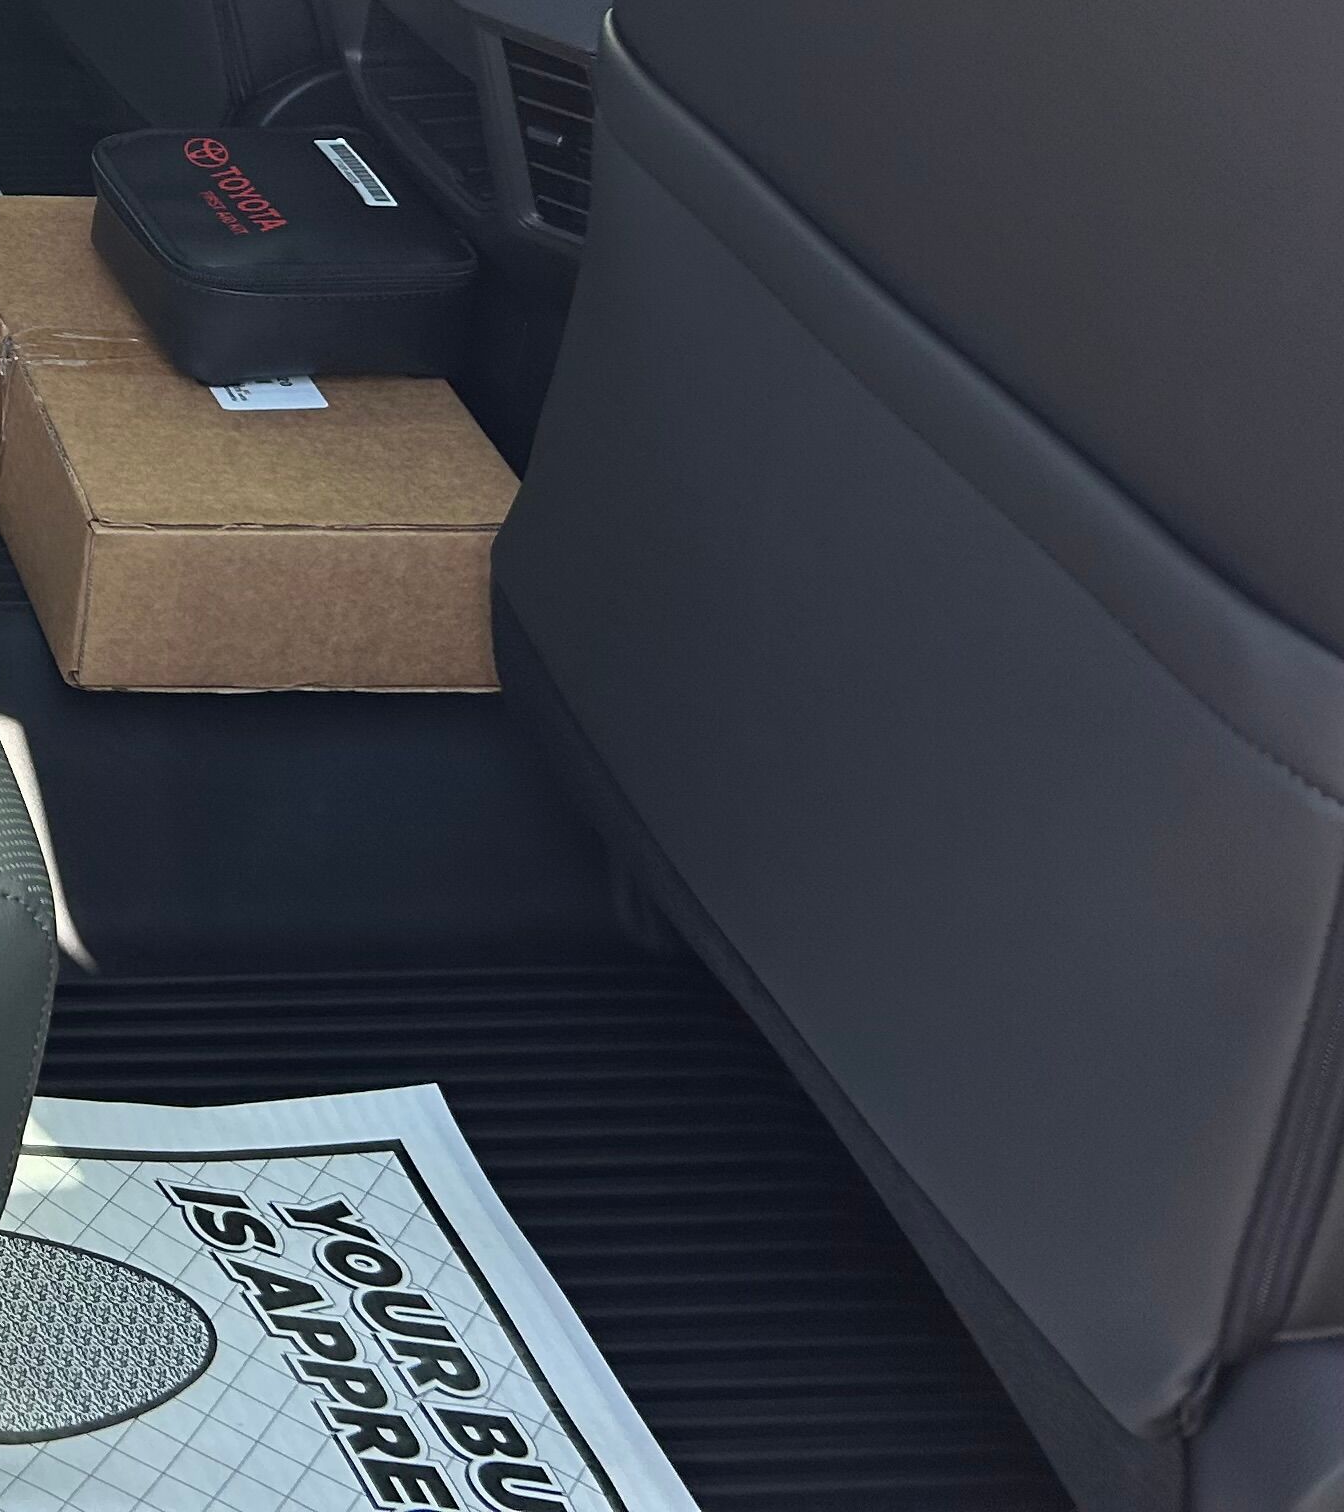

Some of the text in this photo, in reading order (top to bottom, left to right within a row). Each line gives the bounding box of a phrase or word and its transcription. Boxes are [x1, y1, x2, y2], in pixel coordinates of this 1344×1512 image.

[210, 165, 288, 232] TOYOTA
[160, 1180, 283, 1257] IS
[274, 1195, 487, 1398] YOUR
